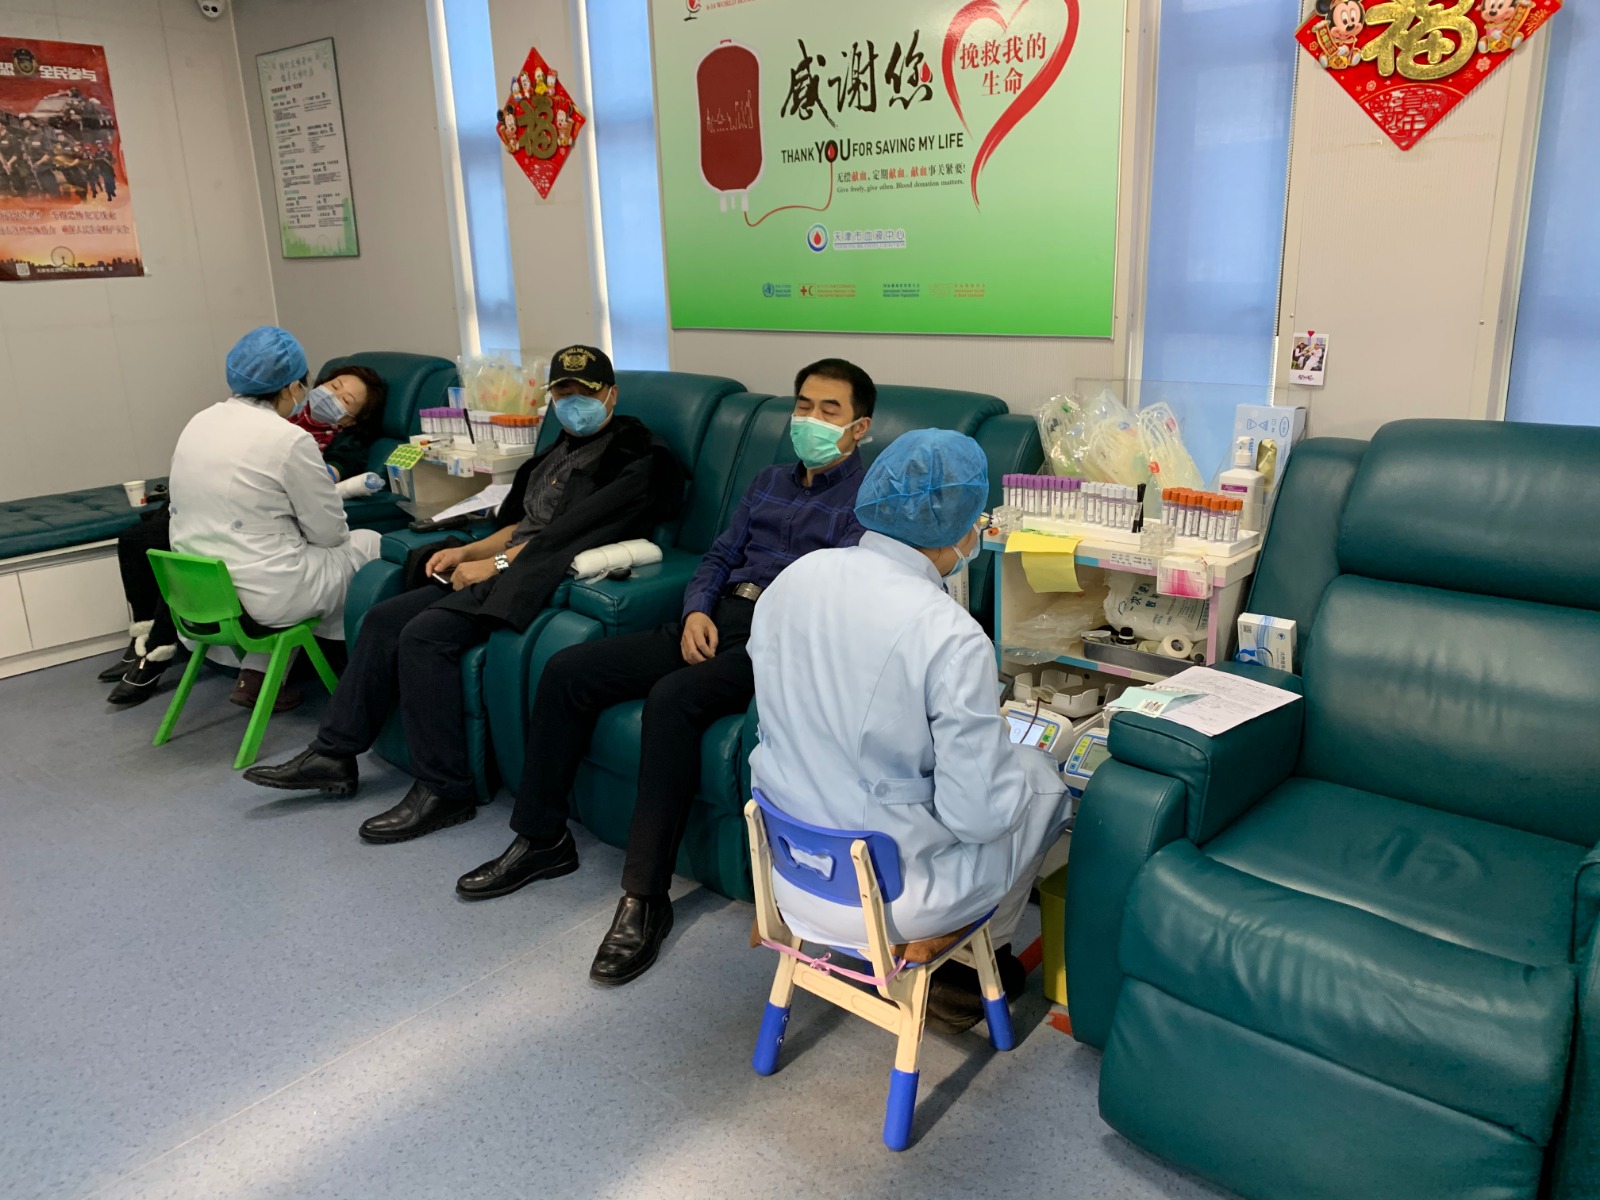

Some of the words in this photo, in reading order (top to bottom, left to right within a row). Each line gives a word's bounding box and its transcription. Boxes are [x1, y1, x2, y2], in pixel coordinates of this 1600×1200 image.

[960, 32, 1047, 70] 挽救我的
[1362, 0, 1478, 80] 福
[39, 65, 97, 82] 全民参与
[781, 29, 933, 130] 感谢您
[981, 66, 1024, 96] 生命
[516, 95, 558, 159] 福
[781, 147, 815, 164] THANK
[815, 138, 851, 164] YOU
[852, 142, 873, 158] FOR
[875, 137, 916, 156] SAVING
[918, 135, 935, 152] MY
[938, 132, 964, 150] LIFE
[867, 185, 878, 193] give
[914, 180, 940, 188] donation
[834, 229, 905, 242] 天津市血液中心
